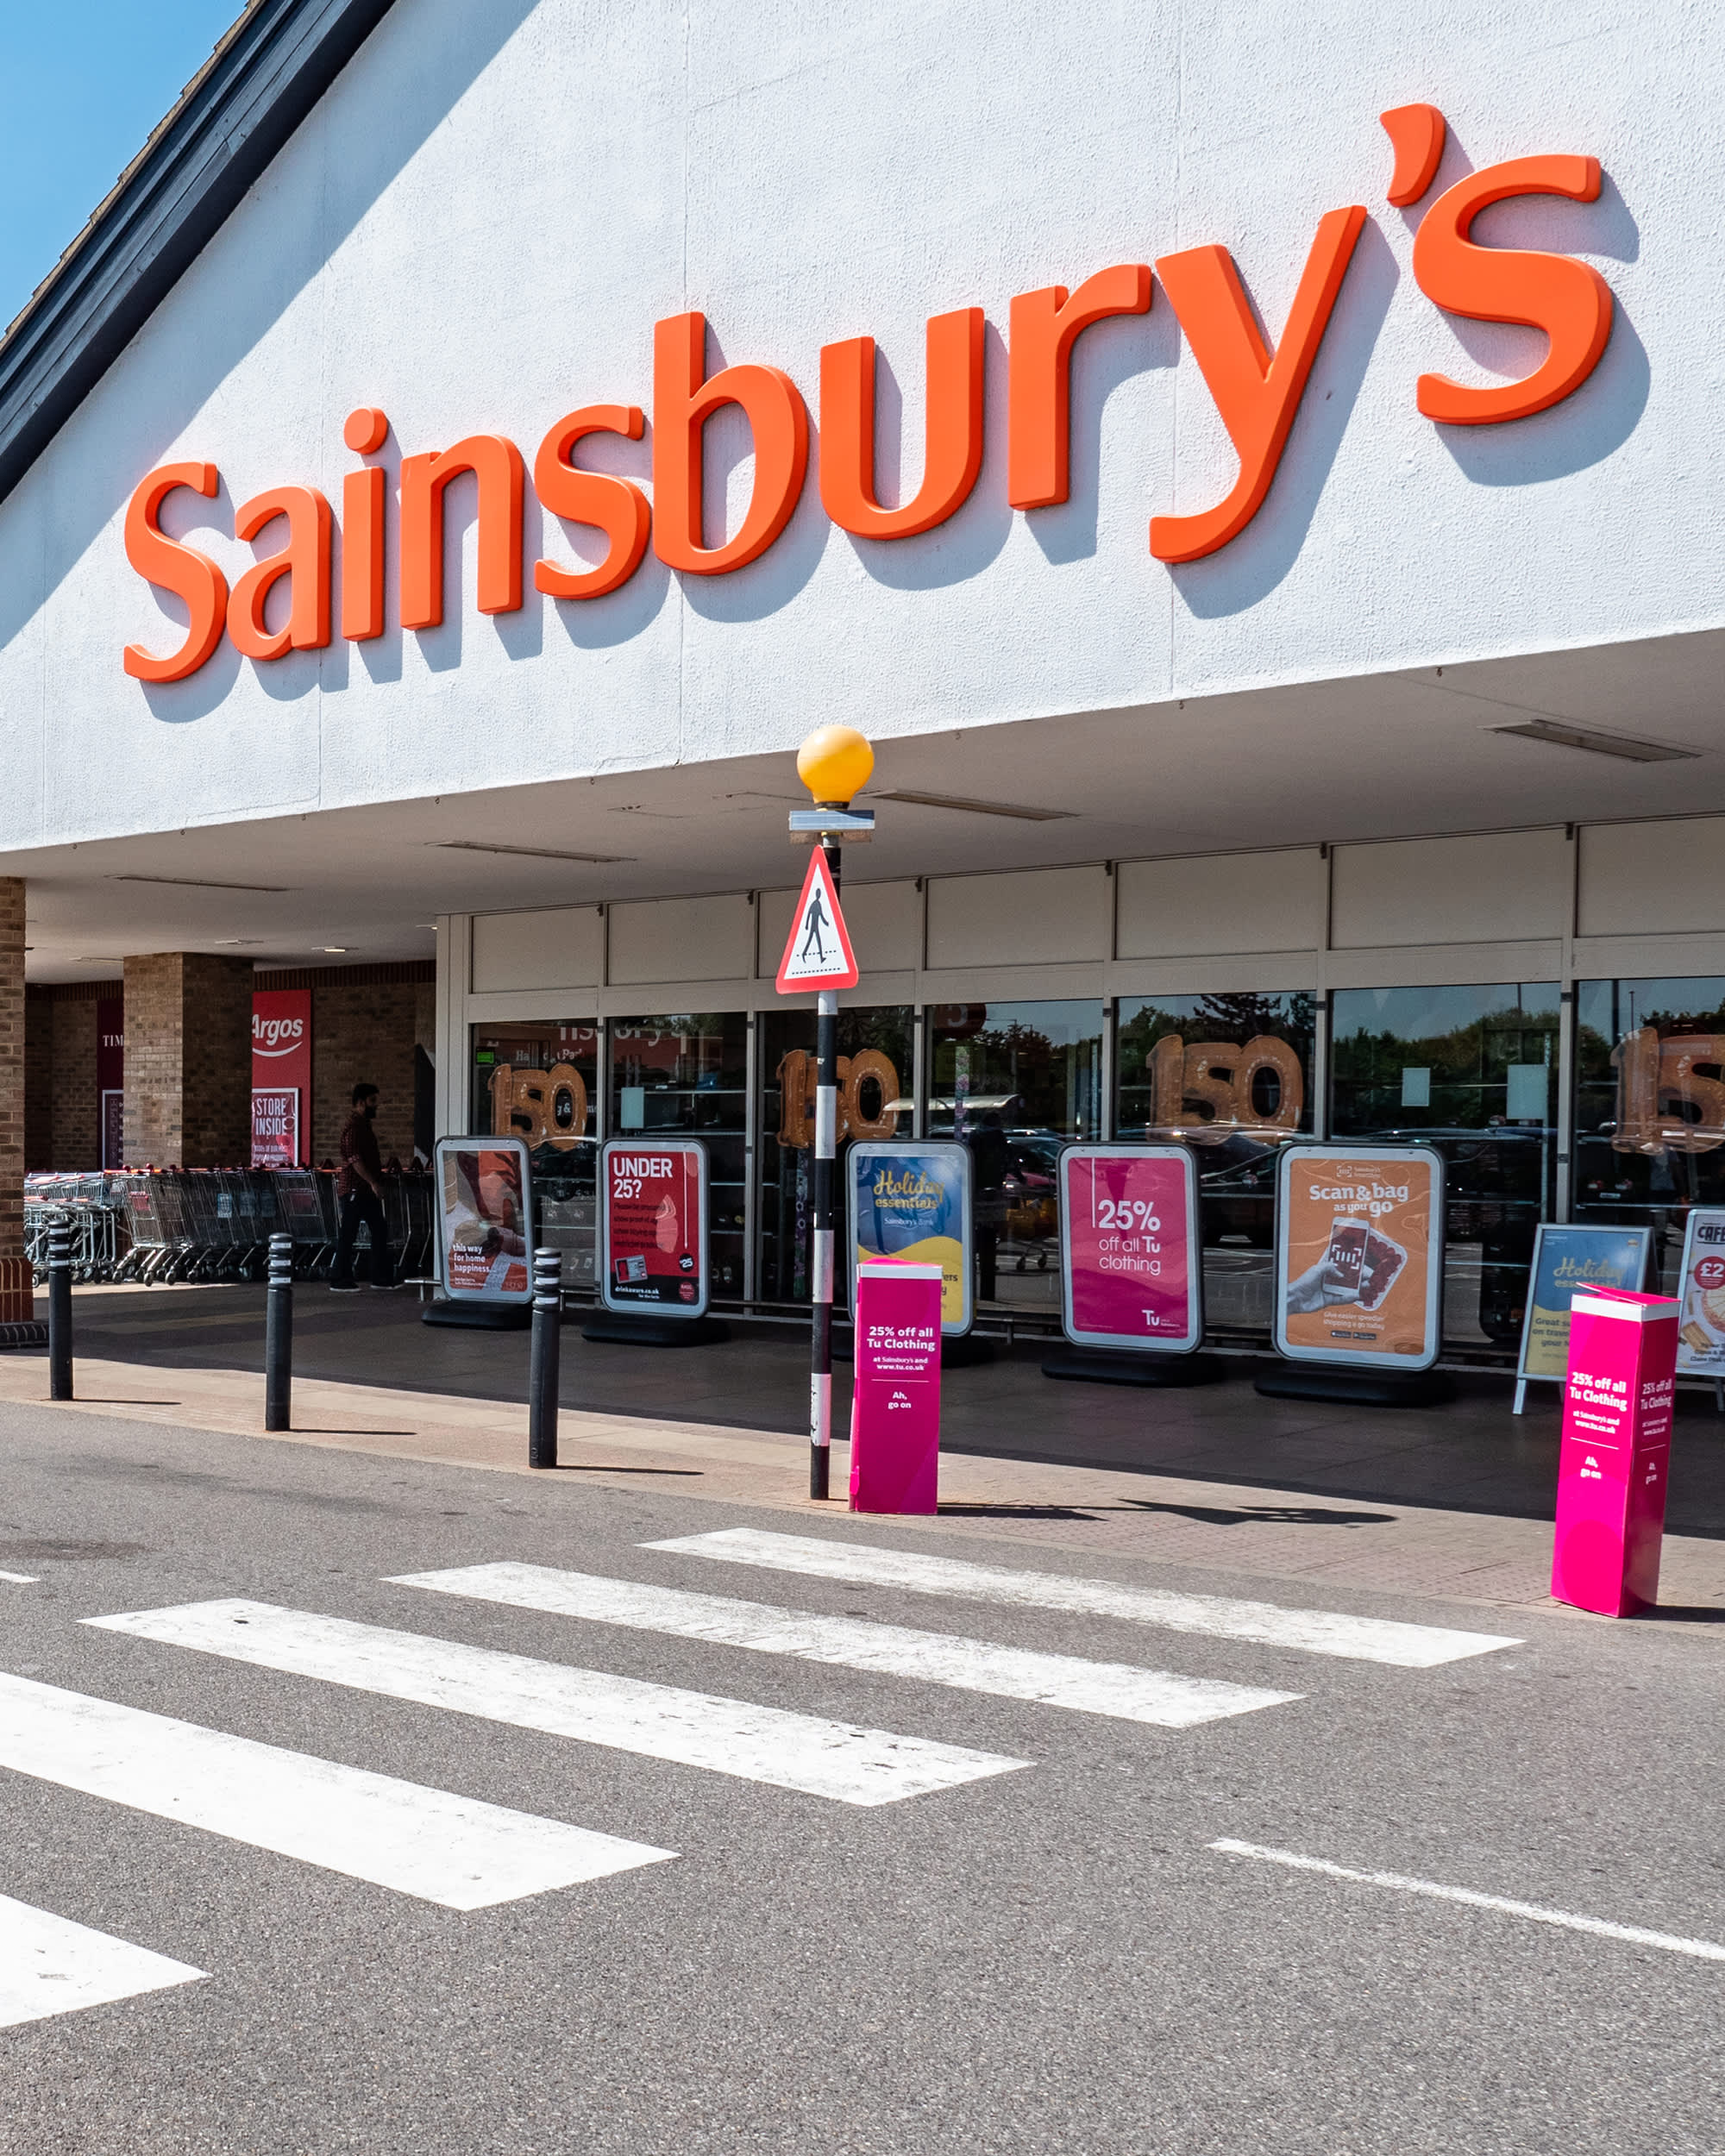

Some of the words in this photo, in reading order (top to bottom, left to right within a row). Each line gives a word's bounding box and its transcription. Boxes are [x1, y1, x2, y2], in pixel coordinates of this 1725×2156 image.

[123, 103, 1614, 683] Sainsbury's
[252, 1013, 304, 1046] Argos
[256, 1097, 287, 1116] STORE
[255, 1117, 287, 1136] INSIDE
[613, 1157, 674, 1178] UNDER
[613, 1178, 643, 1199] 25?
[873, 1169, 945, 1204] Holiday
[1309, 1184, 1354, 1200] Scan
[1355, 1185, 1371, 1201] &
[1371, 1182, 1409, 1202] bag
[875, 1197, 938, 1209] essentials
[1333, 1203, 1346, 1212] as
[1346, 1203, 1367, 1213] you
[1369, 1200, 1393, 1218] go
[1098, 1199, 1161, 1232] 25%
[453, 1243, 467, 1252] this
[467, 1245, 483, 1255] way
[1099, 1236, 1120, 1251] off
[1122, 1238, 1139, 1253] all
[1141, 1235, 1161, 1253] Tu
[454, 1253, 464, 1262] for
[466, 1254, 486, 1263] home
[1099, 1254, 1161, 1276] clothing
[1553, 1256, 1627, 1288] Holiday
[1700, 1262, 1725, 1277] £2
[1141, 1309, 1160, 1326] Tu
[1535, 1317, 1560, 1326] Great
[869, 1326, 895, 1337] 25%
[897, 1326, 916, 1338] off
[918, 1327, 933, 1338] all
[867, 1338, 881, 1348] Tu
[884, 1338, 936, 1352] Clothing
[1571, 1372, 1593, 1388] 25%
[1594, 1377, 1612, 1390] off
[1612, 1381, 1627, 1394] all
[1642, 1383, 1656, 1395] 25%
[1655, 1380, 1665, 1393] off
[892, 1391, 907, 1401] Ah,
[1569, 1386, 1582, 1400] Tu
[1583, 1389, 1628, 1413] Clothing
[1648, 1395, 1672, 1410] Clothing
[888, 1401, 899, 1410] go
[1584, 1455, 1598, 1469] Ah,
[1579, 1468, 1590, 1478] go
[1590, 1470, 1602, 1480] on
